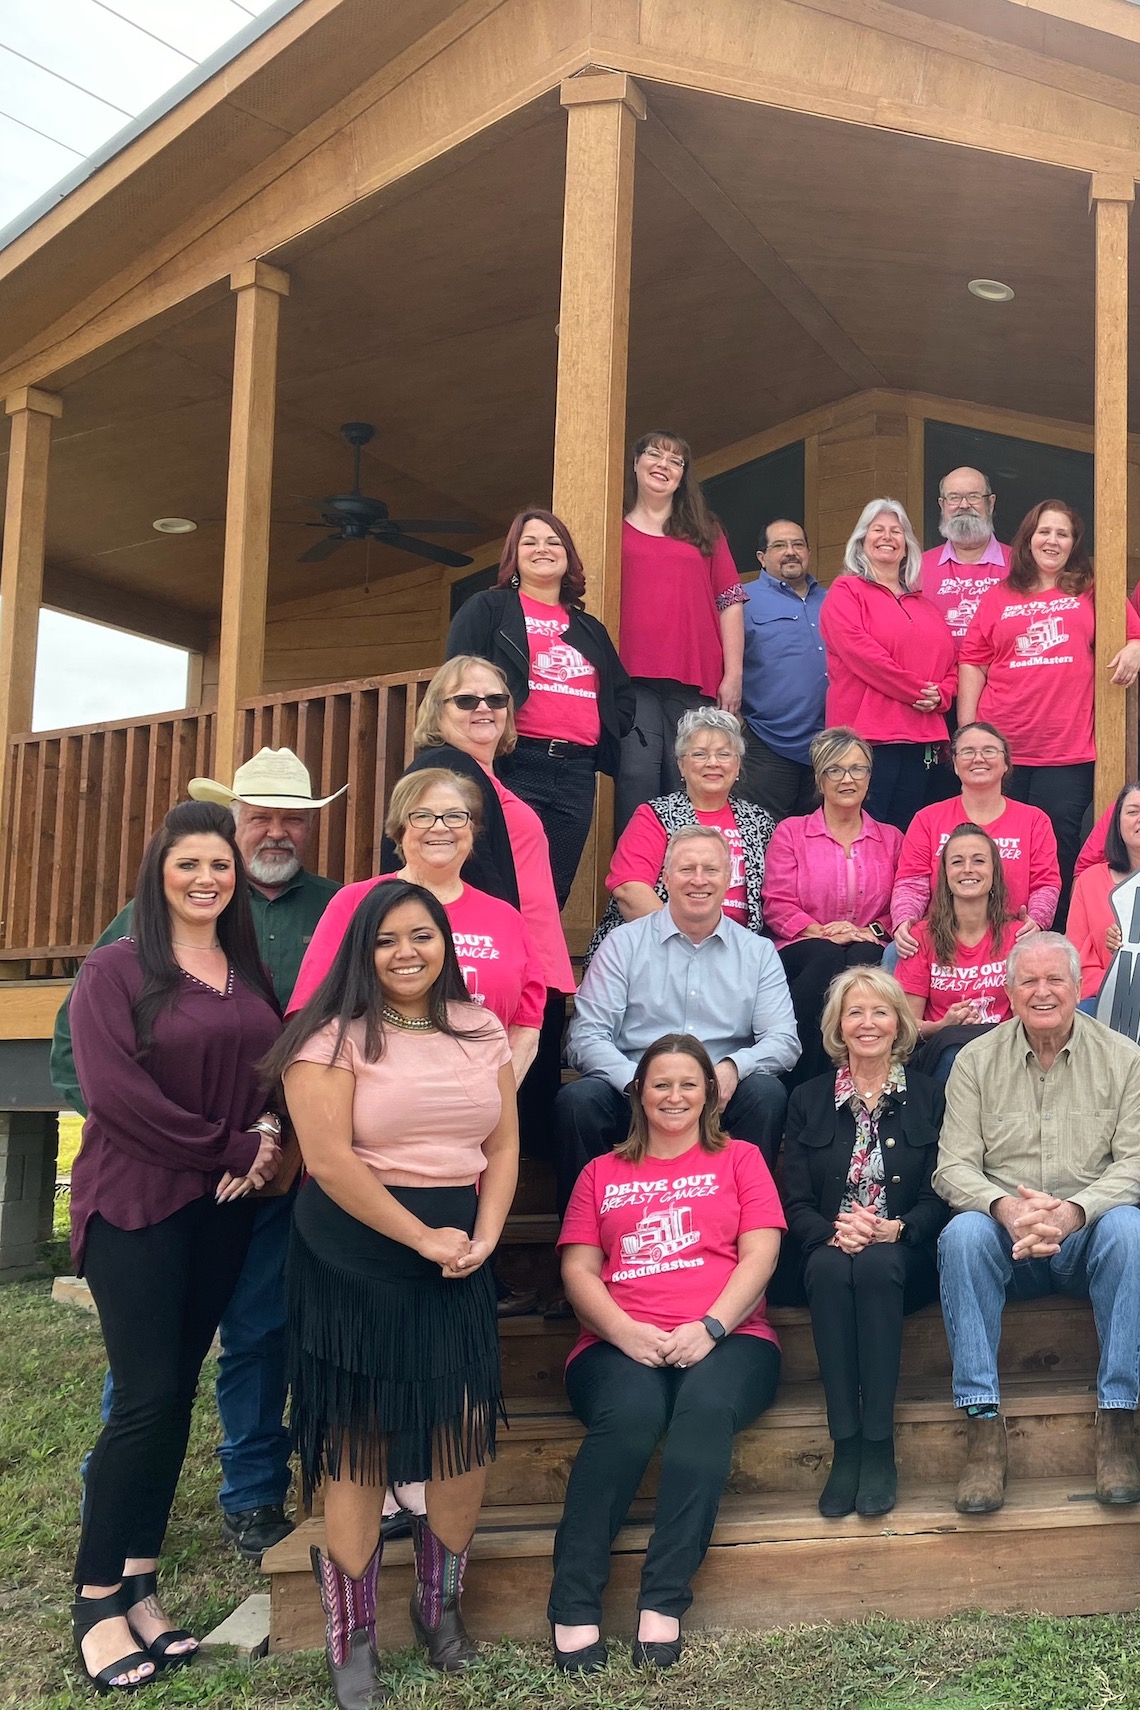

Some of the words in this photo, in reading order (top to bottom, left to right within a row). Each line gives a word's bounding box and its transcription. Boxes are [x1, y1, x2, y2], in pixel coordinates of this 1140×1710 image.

[941, 577, 973, 588] DRVE
[974, 577, 1000, 588] OUT
[1049, 596, 1078, 606] OUT
[526, 626, 556, 638] EAST
[1009, 655, 1074, 669] RoadMasters
[528, 680, 597, 699] RoadMasters
[723, 828, 742, 838] OU
[451, 932, 494, 948] OUT
[455, 946, 500, 960] ANCER
[930, 963, 979, 980] DRIVE
[973, 974, 1007, 991] CANCE
[605, 1179, 668, 1198] DRIVE
[672, 1174, 716, 1189] OUT
[600, 1192, 659, 1215] BREAST
[659, 1185, 719, 1203] CANCER
[612, 1258, 704, 1282] RoadMasters
